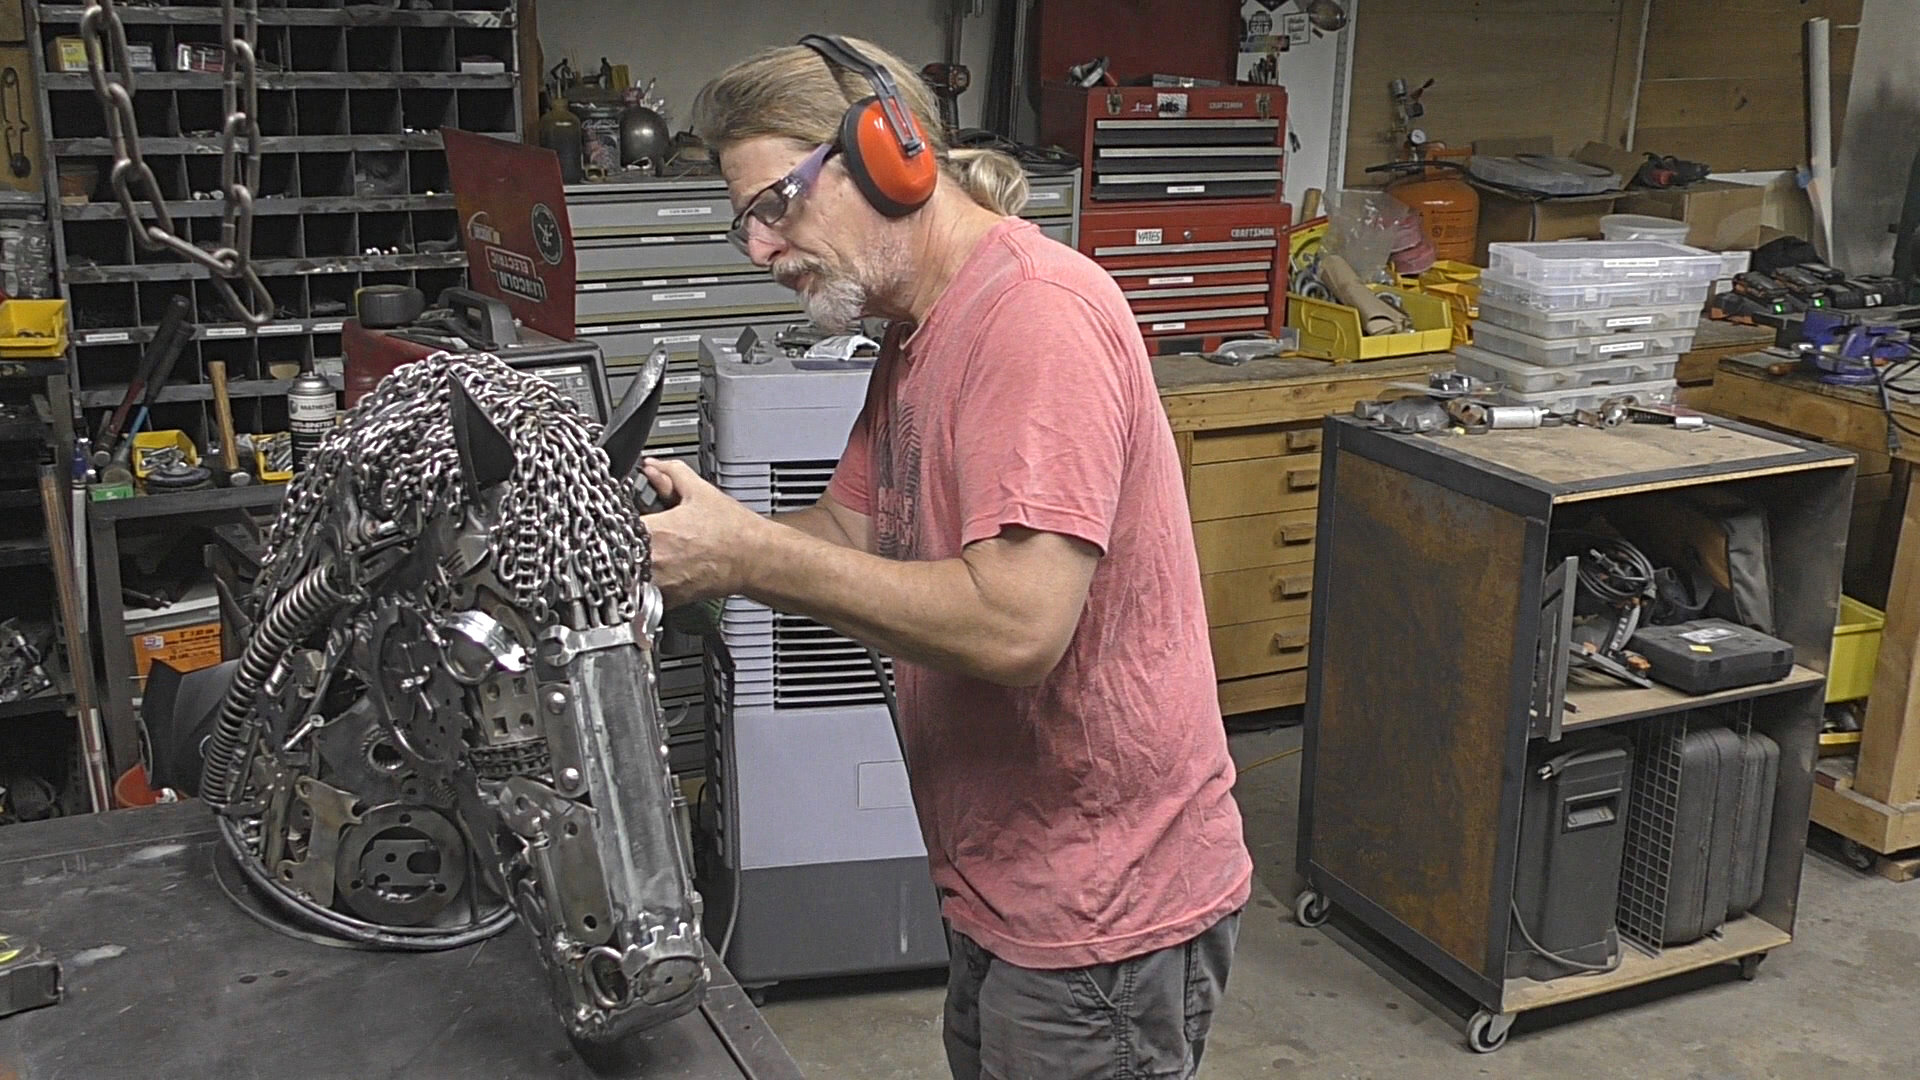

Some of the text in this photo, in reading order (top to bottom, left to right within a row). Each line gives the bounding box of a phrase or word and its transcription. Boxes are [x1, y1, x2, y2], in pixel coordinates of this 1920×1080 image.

[1137, 231, 1161, 243] YATES
[1230, 227, 1275, 238] CRAFTSMAN
[489, 250, 530, 275] ELECTRIC
[499, 271, 544, 299] LINCOLN
